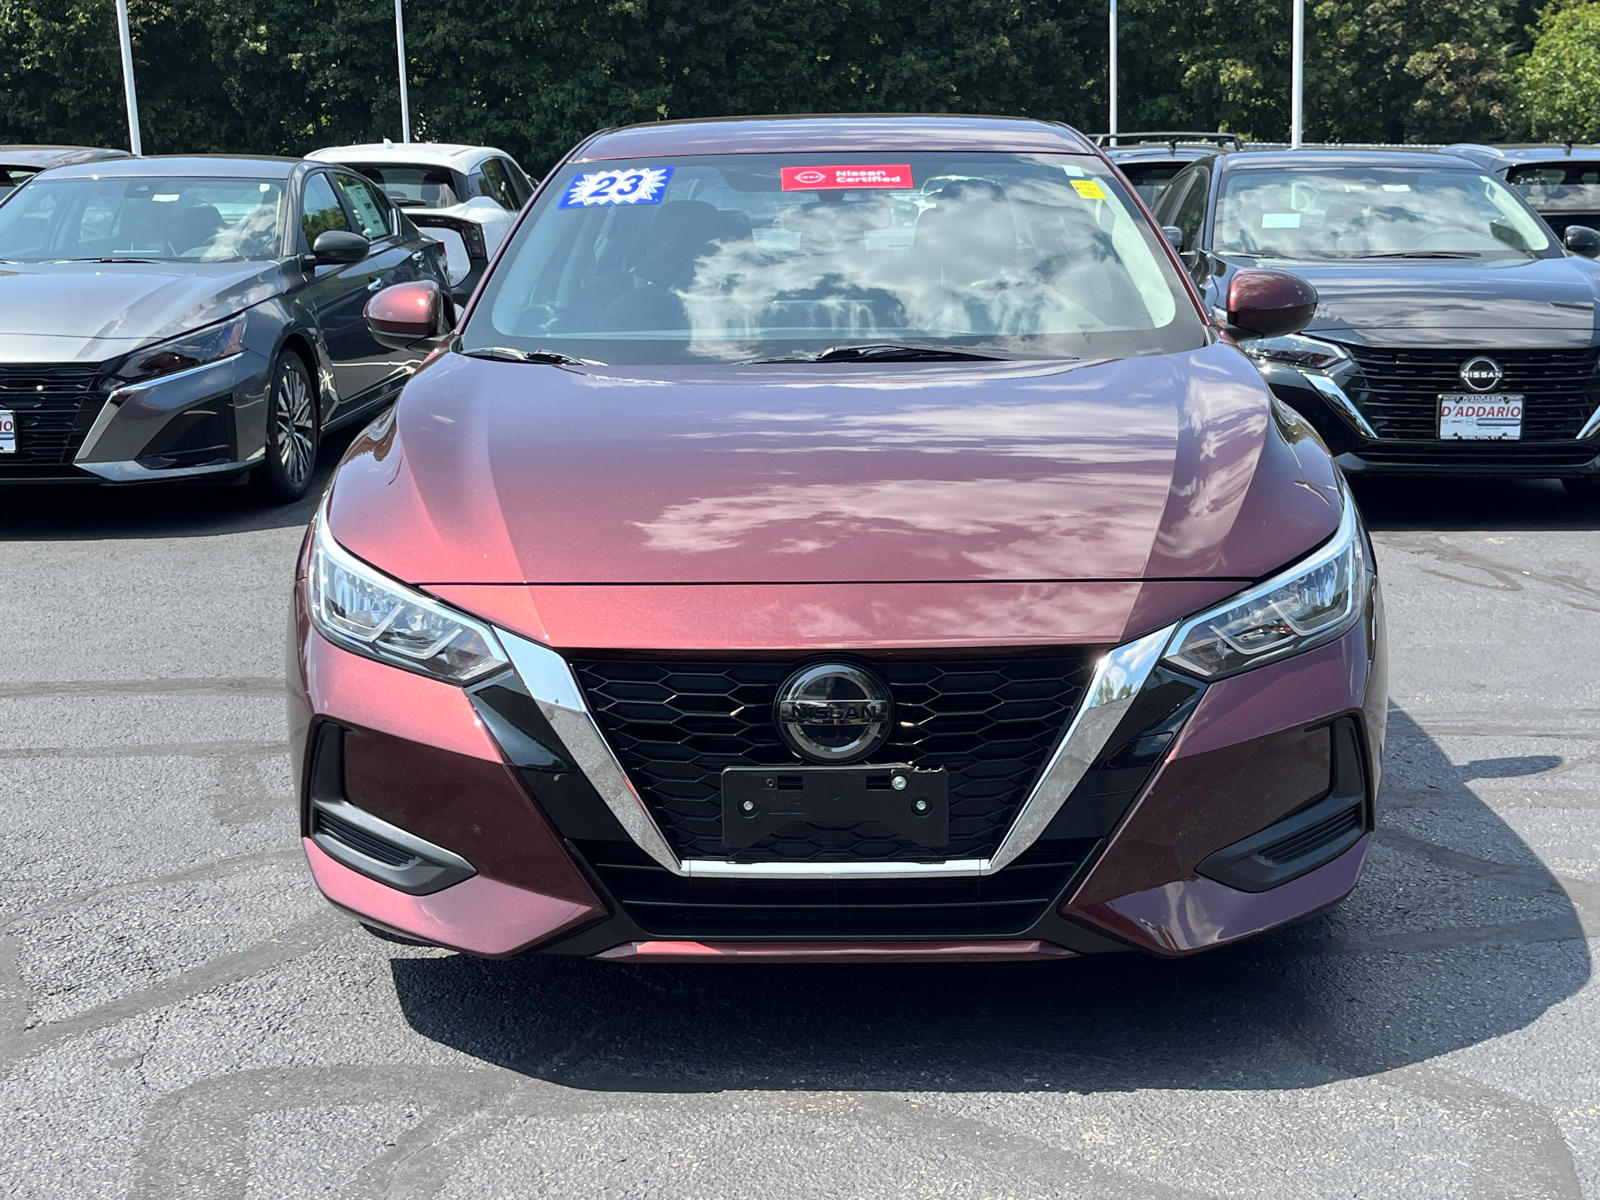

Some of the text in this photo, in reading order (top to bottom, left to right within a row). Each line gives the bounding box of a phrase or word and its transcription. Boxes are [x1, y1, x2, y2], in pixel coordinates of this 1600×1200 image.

[586, 175, 644, 198] 23
[1462, 396, 1503, 404] D'ADDARIO
[1441, 406, 1521, 417] D'ADDARIO
[791, 706, 876, 719] NISSAN
